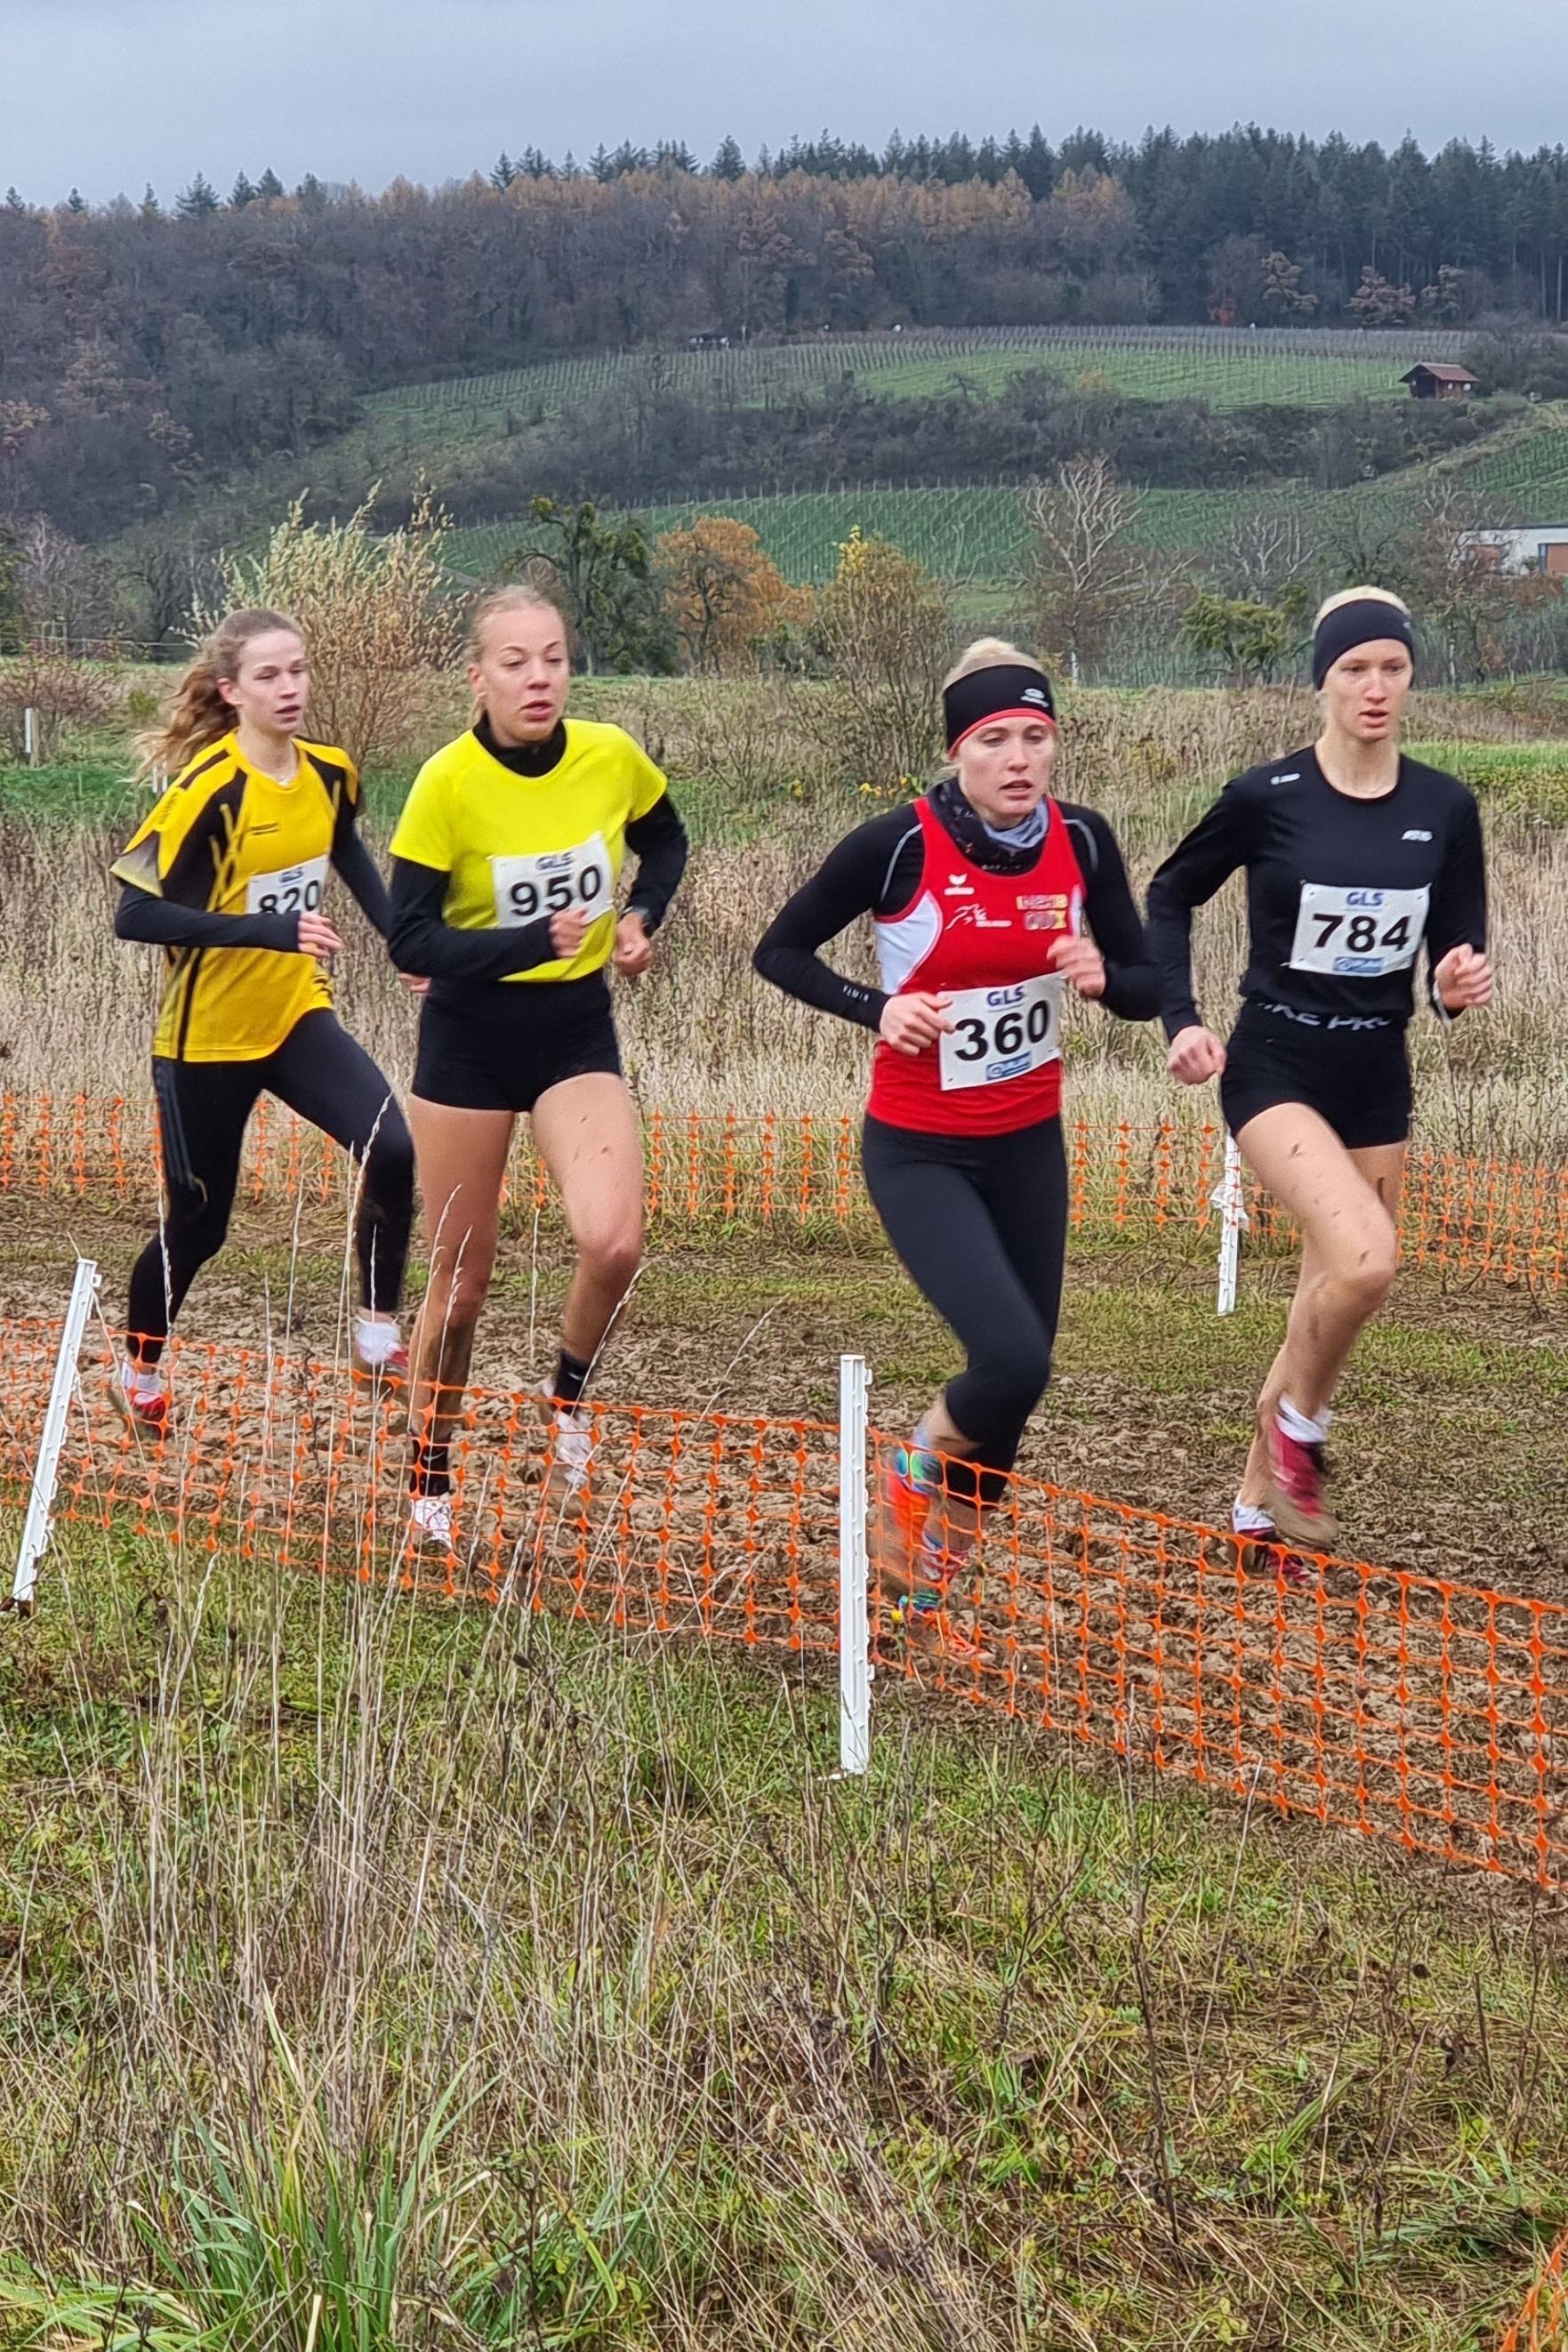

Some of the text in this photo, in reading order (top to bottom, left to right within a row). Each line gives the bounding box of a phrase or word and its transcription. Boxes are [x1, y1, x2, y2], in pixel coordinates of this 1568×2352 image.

[258, 880, 321, 914] 820
[511, 866, 601, 916] 950
[1346, 891, 1384, 906] GLS
[1313, 913, 1412, 954] 784
[986, 985, 1026, 1006] GLS
[954, 1000, 1049, 1061] 360
